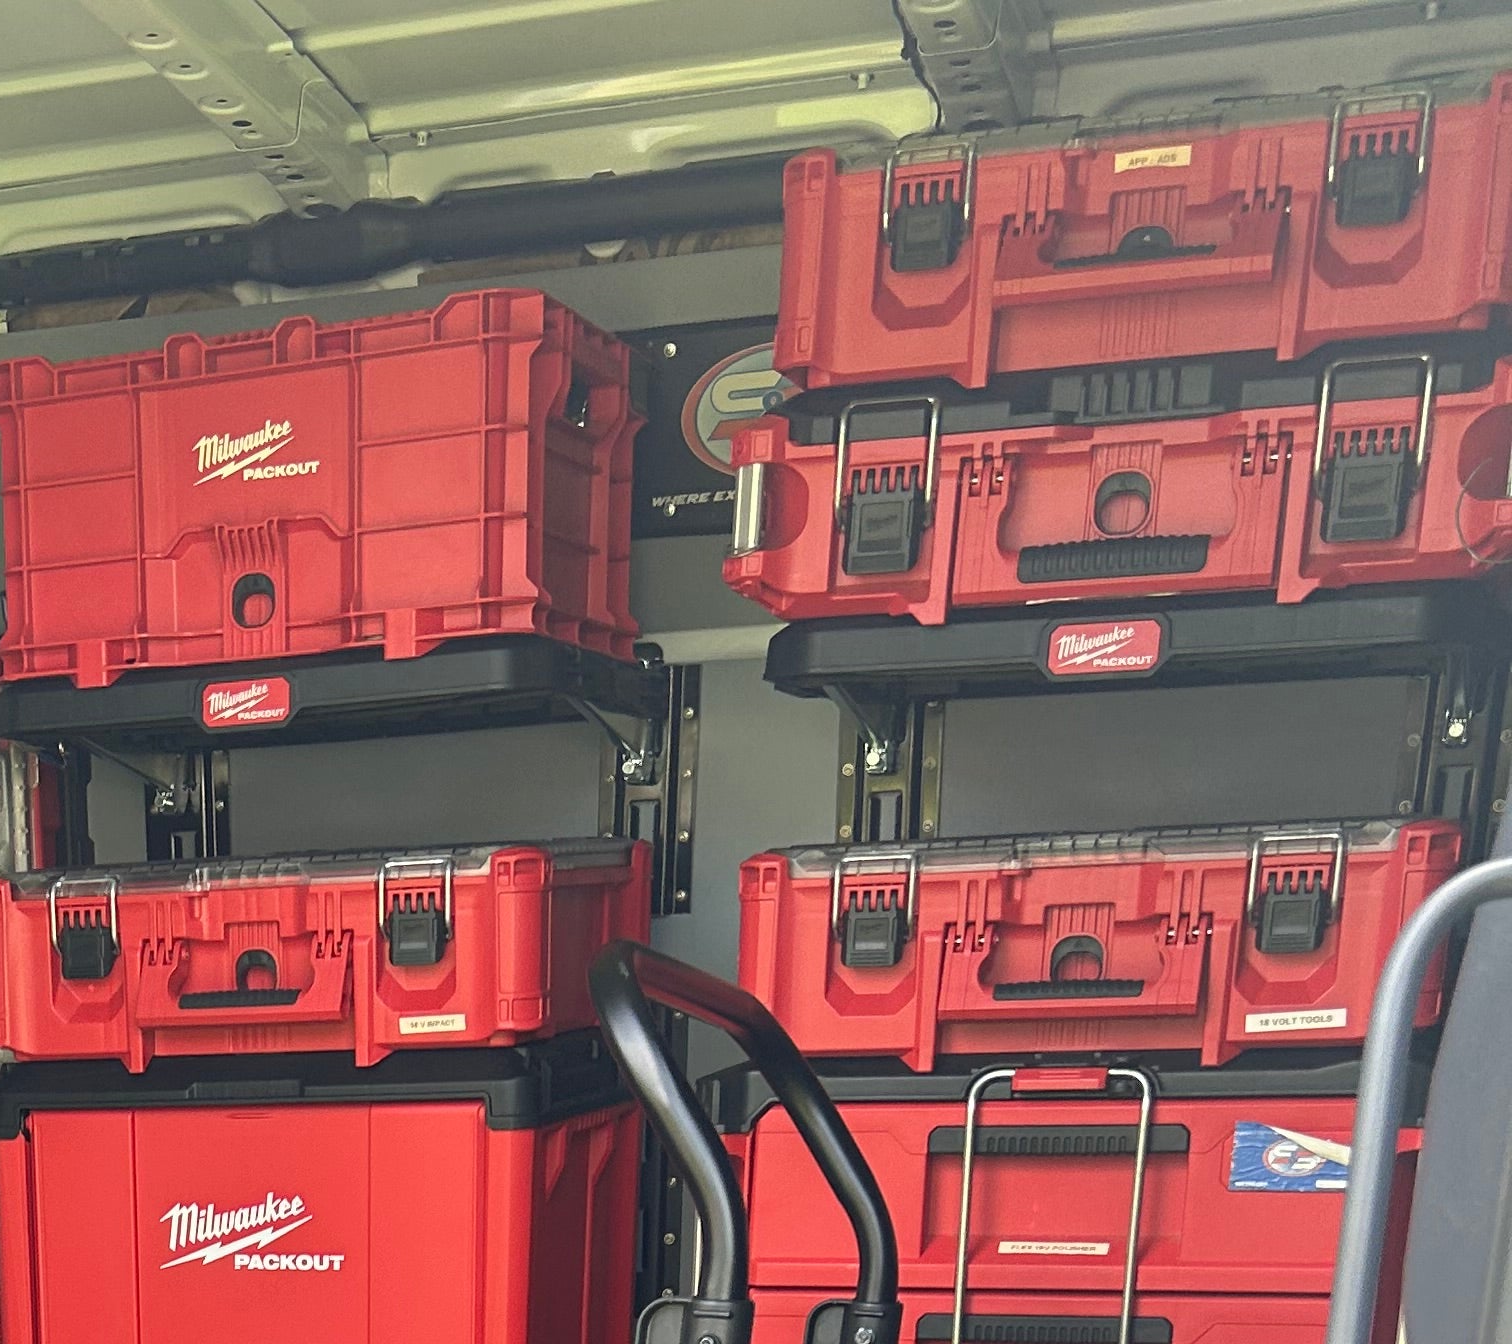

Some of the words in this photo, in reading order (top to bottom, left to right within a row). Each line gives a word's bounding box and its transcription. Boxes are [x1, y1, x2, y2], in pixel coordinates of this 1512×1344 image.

[191, 419, 293, 473] Milwaukee
[243, 460, 320, 481] PACKOUT
[652, 491, 711, 507] WHERE
[1055, 626, 1135, 660] Milwaukee
[1092, 655, 1153, 668] PACKOUT
[206, 683, 268, 715] Milwaukee
[237, 708, 285, 720] PACKOUT
[1272, 1017, 1298, 1026] VOLT
[1300, 1014, 1333, 1024] TOOLS
[159, 1191, 306, 1252] Milwaukee
[234, 1254, 345, 1271] PACKOUT
